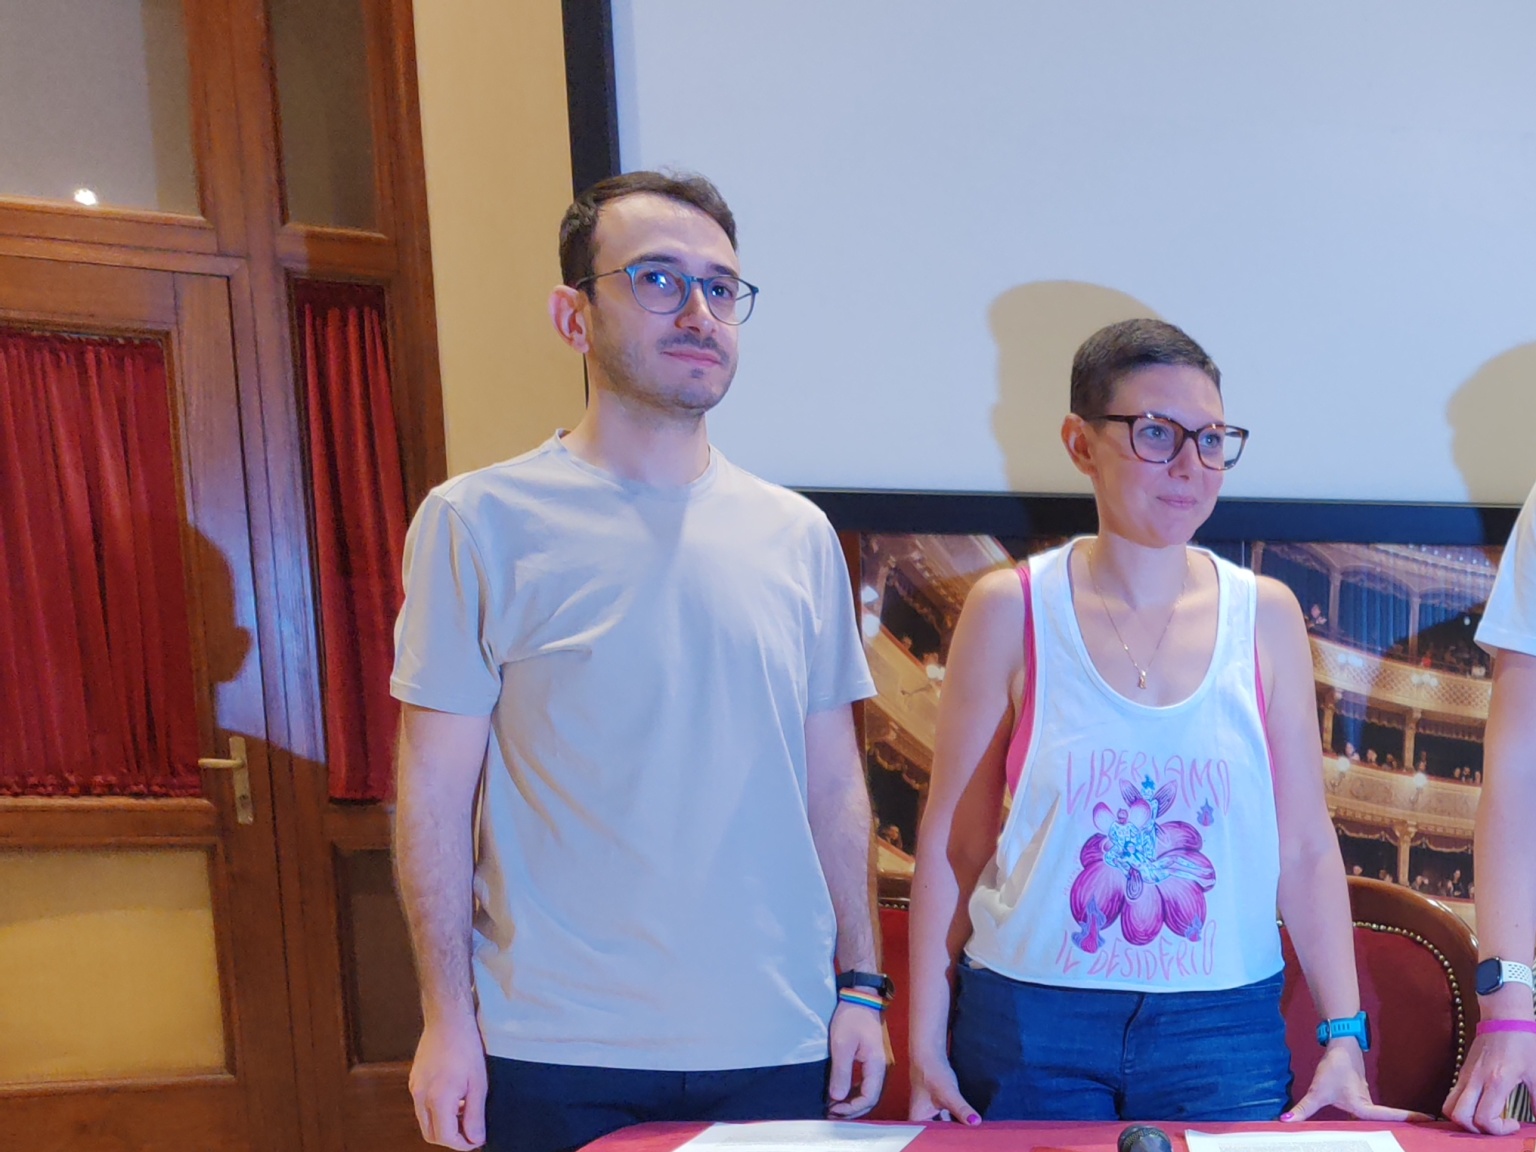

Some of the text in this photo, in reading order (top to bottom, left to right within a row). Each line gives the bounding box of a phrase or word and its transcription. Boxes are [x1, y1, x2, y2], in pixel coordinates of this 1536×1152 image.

[1067, 748, 1230, 815] LIBERIAMO
[1055, 920, 1216, 981] IL DESIDERIO
